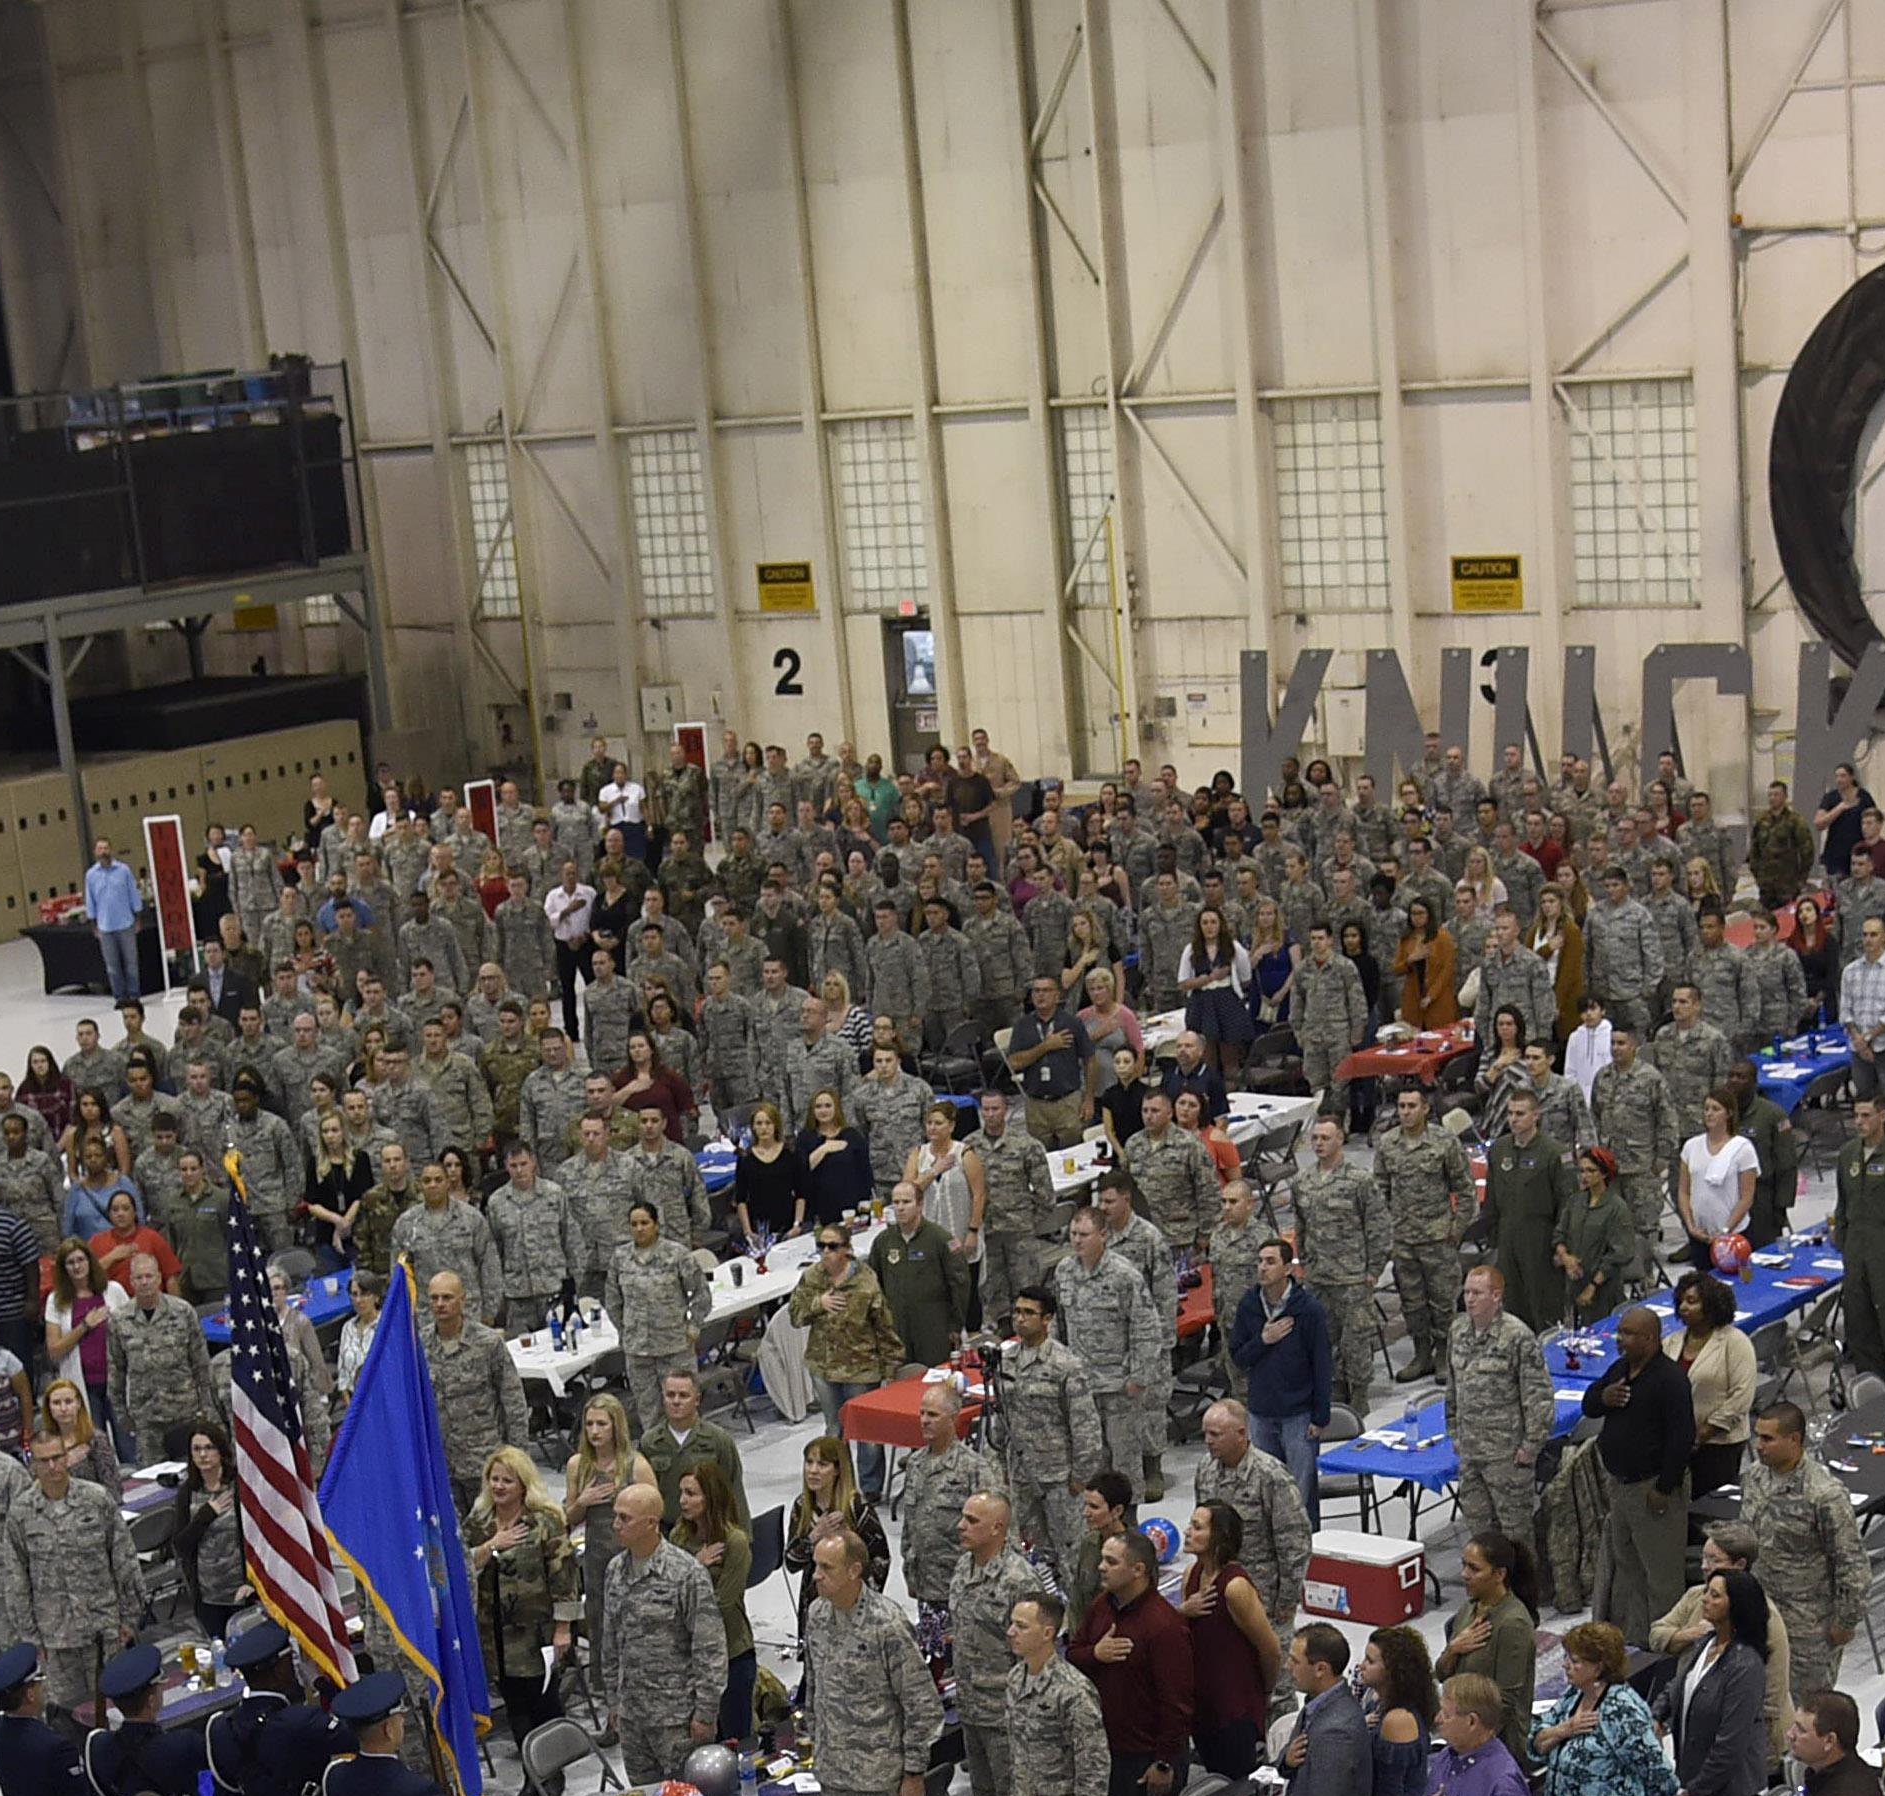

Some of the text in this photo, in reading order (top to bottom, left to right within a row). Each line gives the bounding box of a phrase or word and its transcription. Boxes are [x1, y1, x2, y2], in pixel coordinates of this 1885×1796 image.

[764, 568, 806, 581] CAUTION
[1460, 562, 1512, 576] CAUTION
[772, 647, 804, 696] 2
